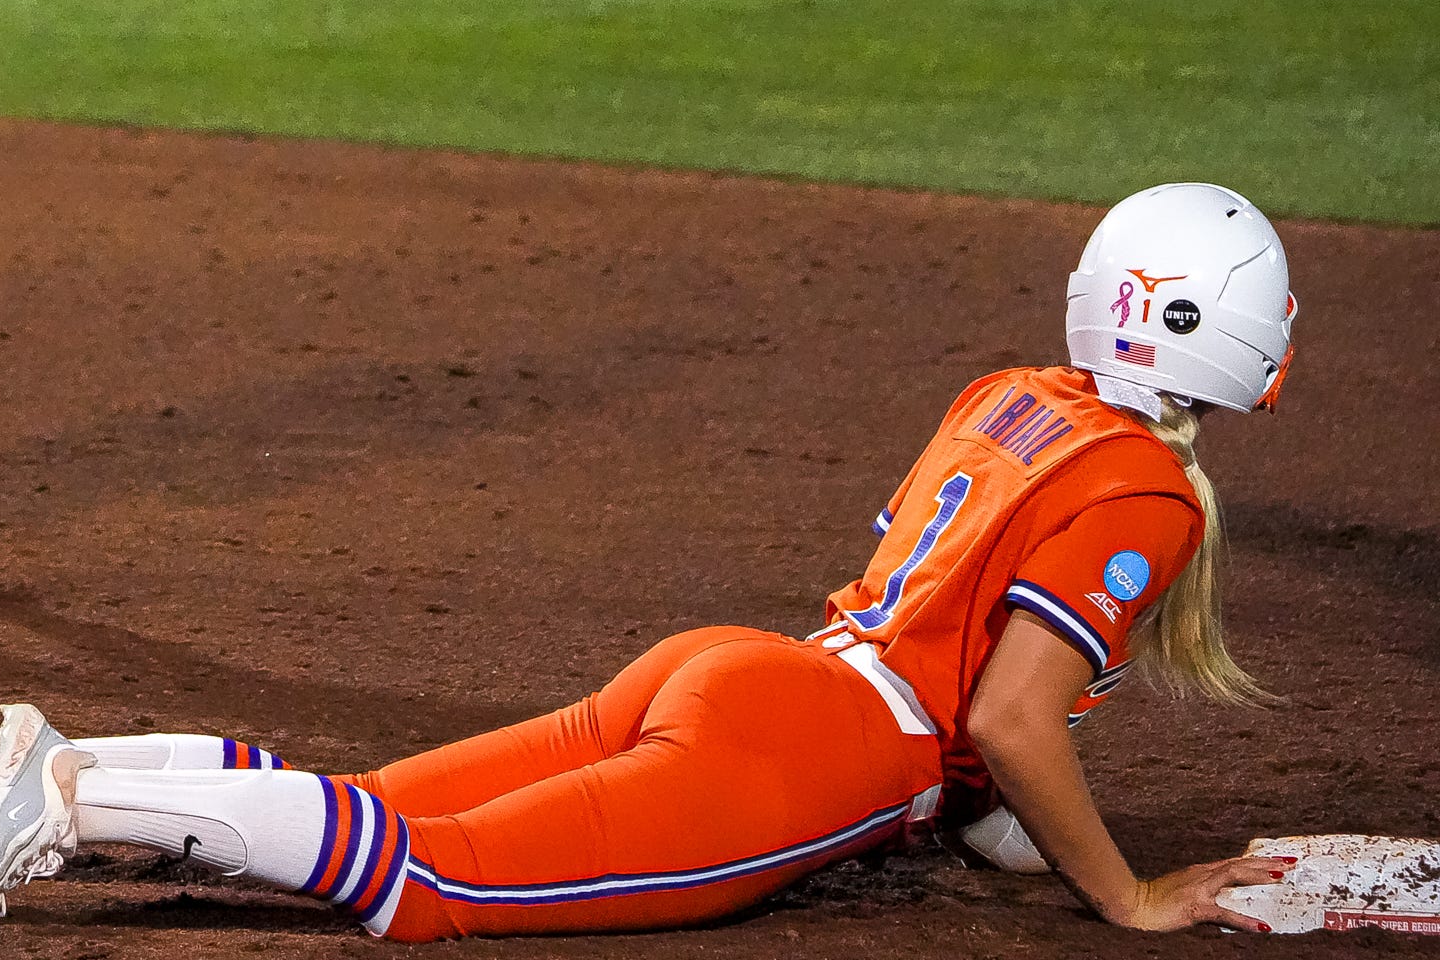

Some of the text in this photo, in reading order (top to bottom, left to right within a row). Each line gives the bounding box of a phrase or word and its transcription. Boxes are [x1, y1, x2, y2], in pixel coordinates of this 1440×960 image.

[1141, 298, 1151, 323] 1
[1165, 310, 1199, 321] UNITY
[843, 471, 973, 632] 1
[1107, 563, 1140, 597] NCAA
[1085, 592, 1122, 622] ACC
[1381, 920, 1409, 932] SUPER
